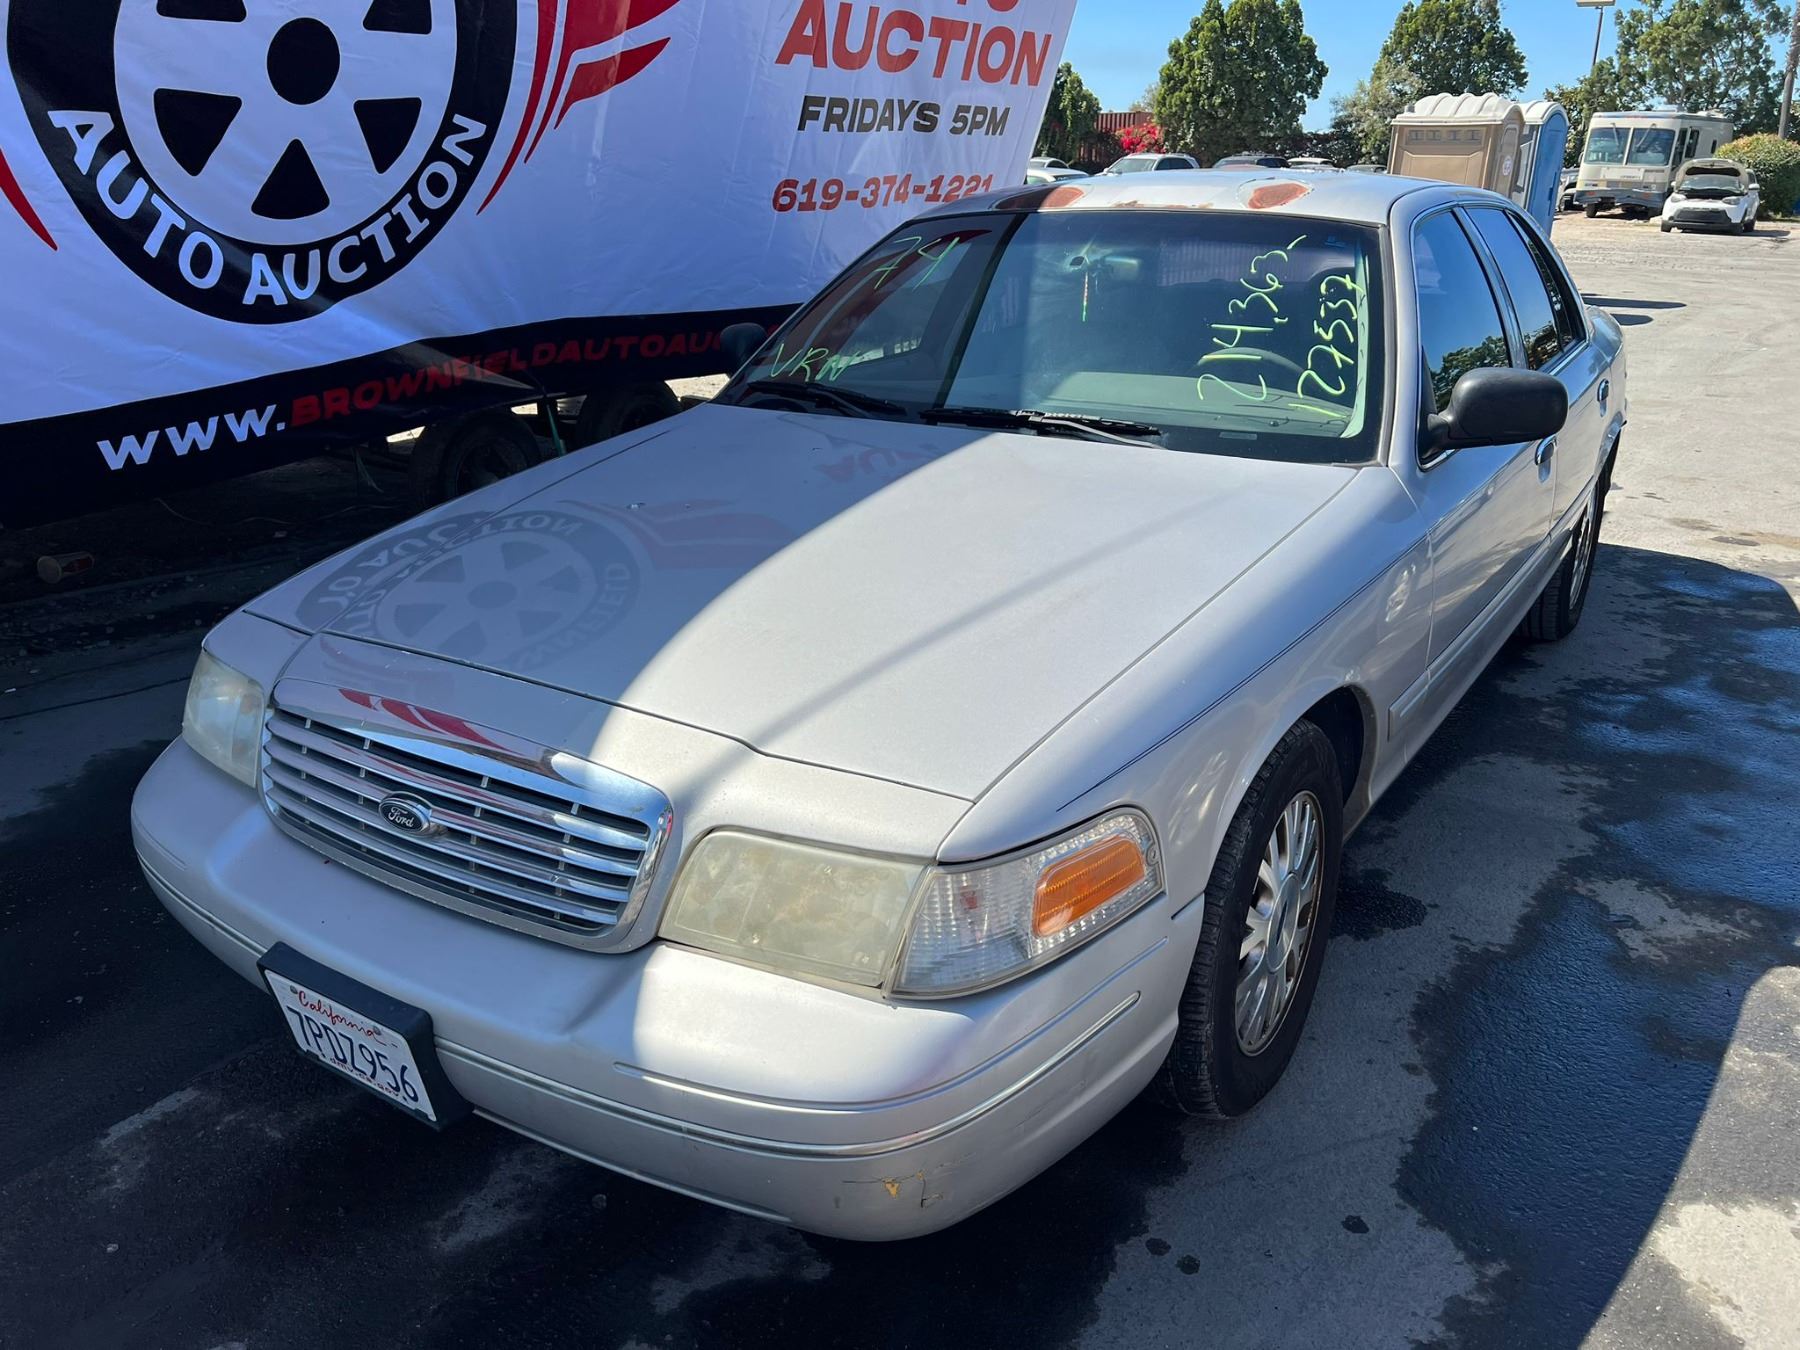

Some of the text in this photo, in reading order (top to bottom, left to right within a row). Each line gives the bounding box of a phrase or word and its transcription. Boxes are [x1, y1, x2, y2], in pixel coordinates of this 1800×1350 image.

[775, 0, 1052, 86] AUCTION
[797, 95, 1010, 136] FRIDAYS 5PM
[48, 110, 487, 306] AUTO AUCTION
[772, 174, 994, 212] 619-374-1221
[387, 806, 416, 828] Ford
[298, 990, 387, 1047] California
[286, 1005, 420, 1103] 7PDZ956
